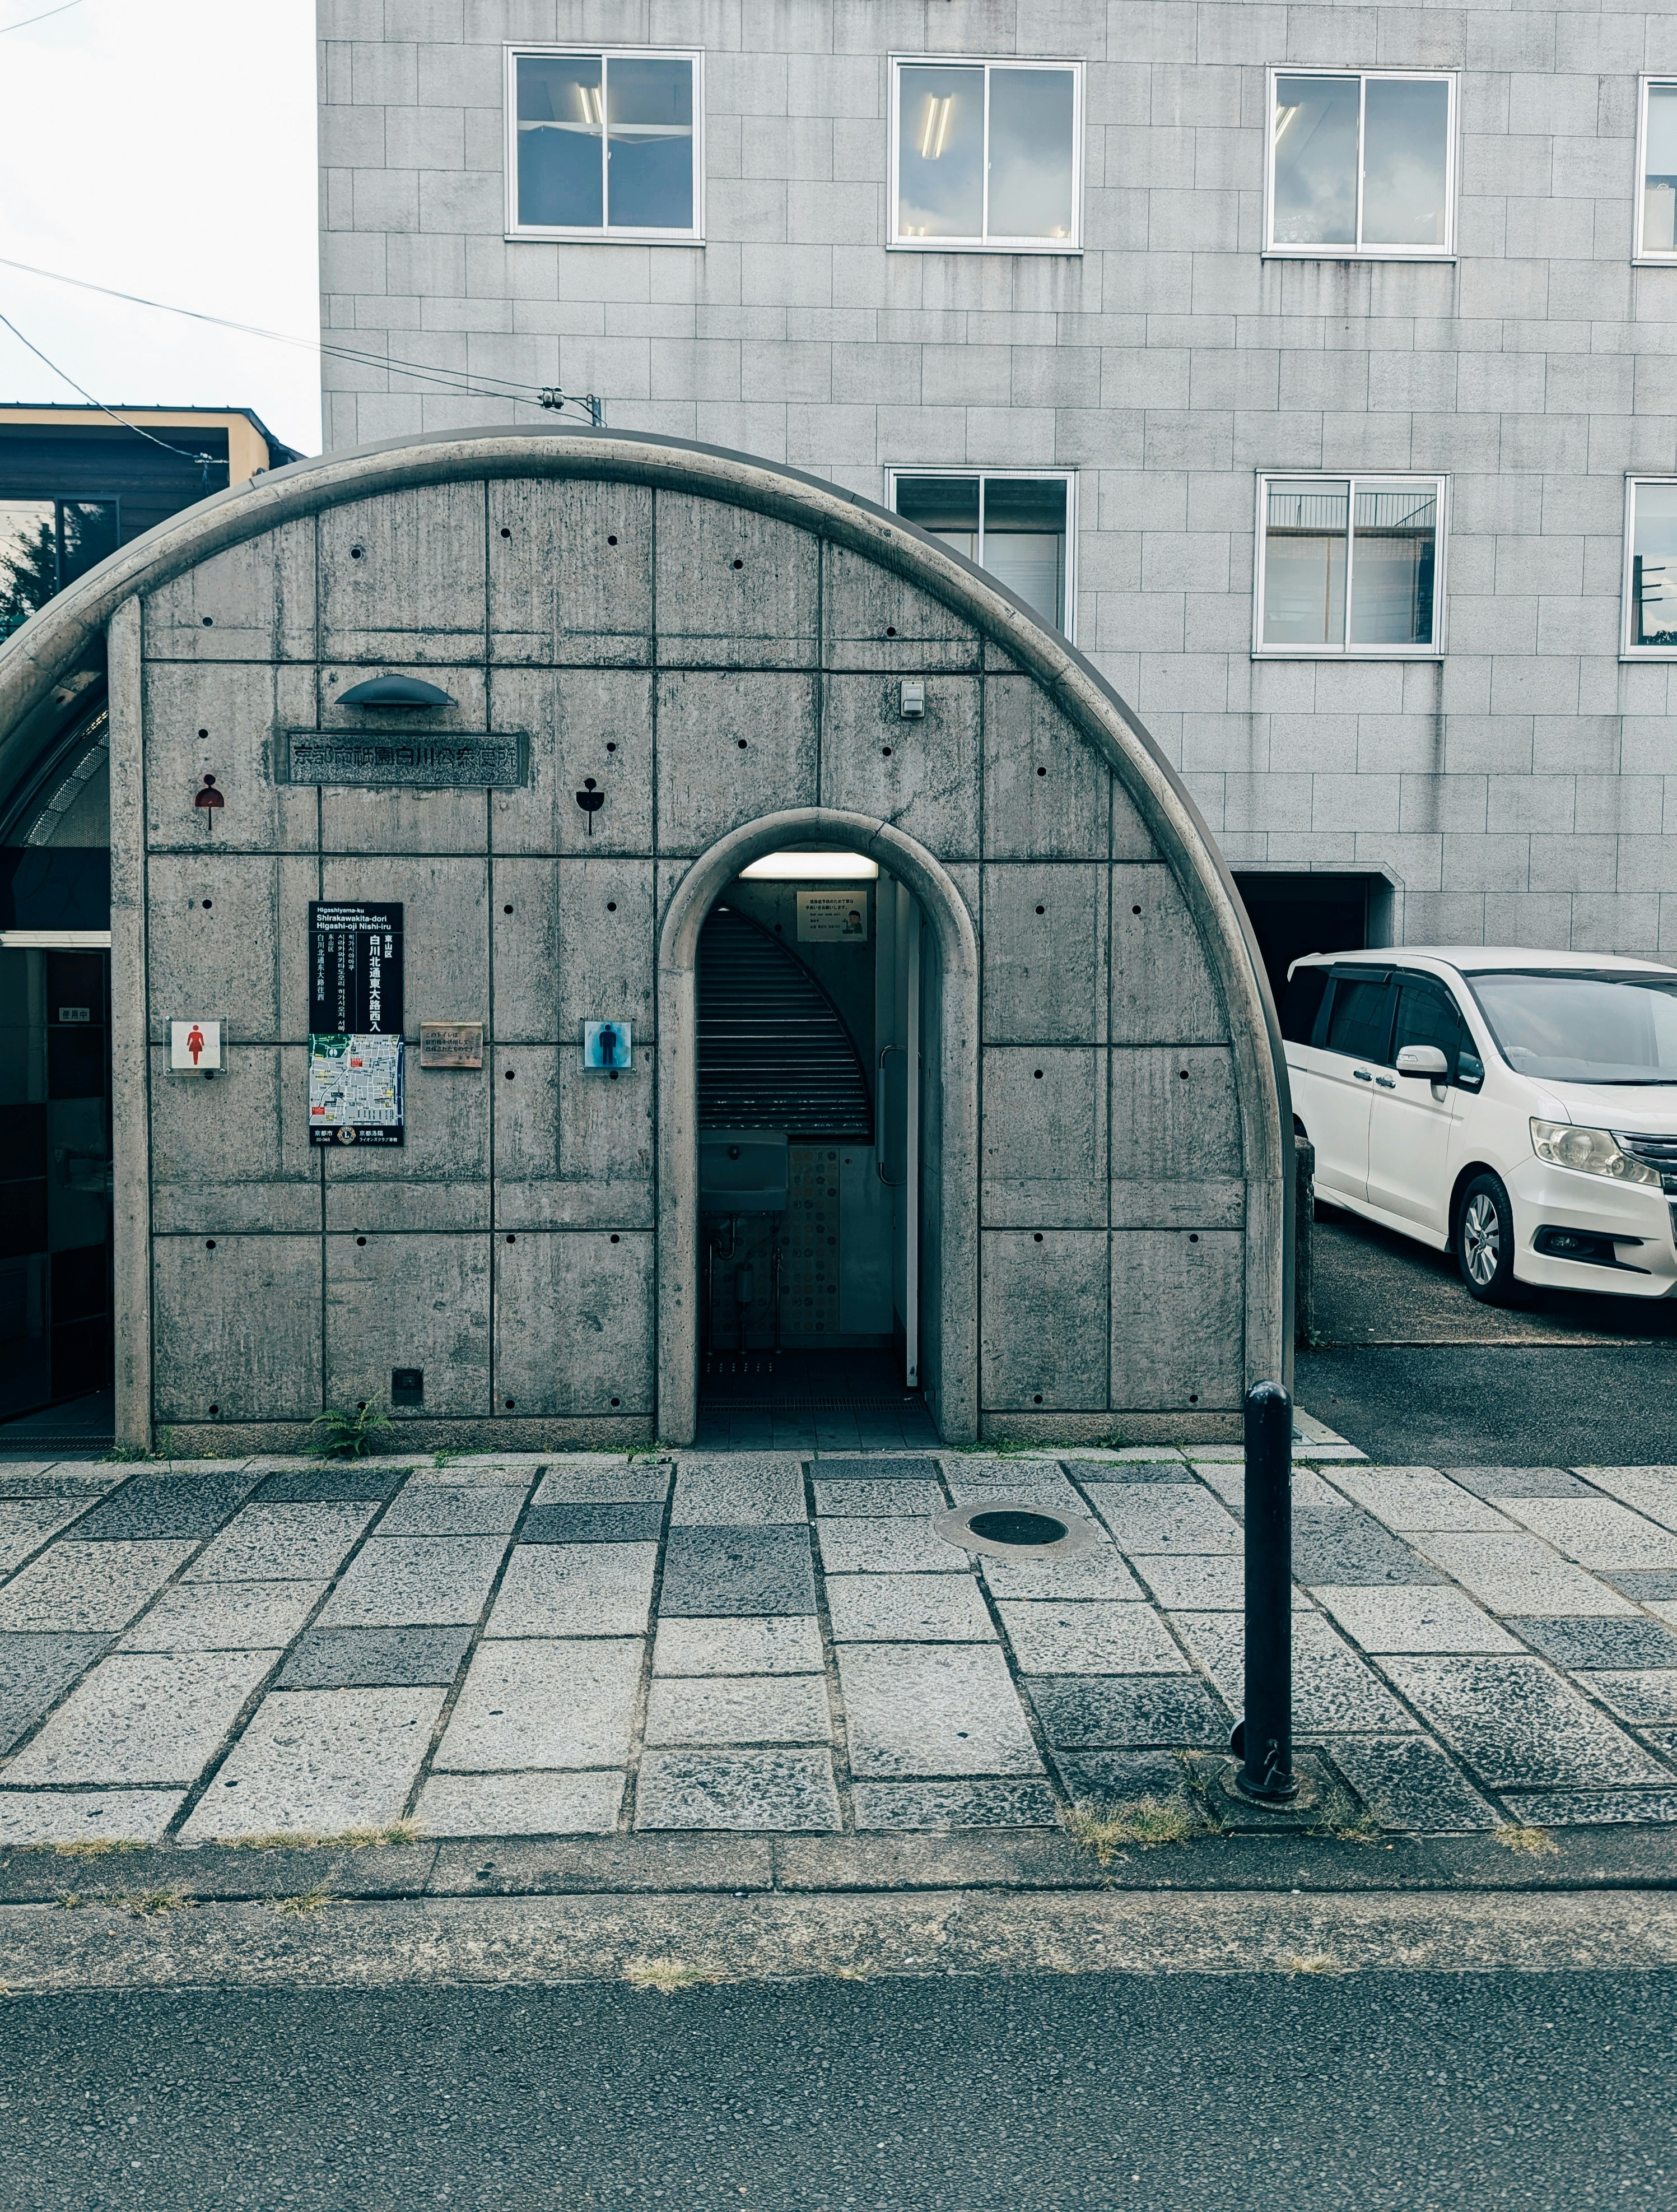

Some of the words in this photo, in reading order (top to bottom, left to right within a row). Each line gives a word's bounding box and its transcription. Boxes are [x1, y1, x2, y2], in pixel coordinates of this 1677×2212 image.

[384, 935, 393, 958] 東山区
[369, 935, 381, 1032] 白川北通東大路西入
[62, 1010, 87, 1020] 使用中
